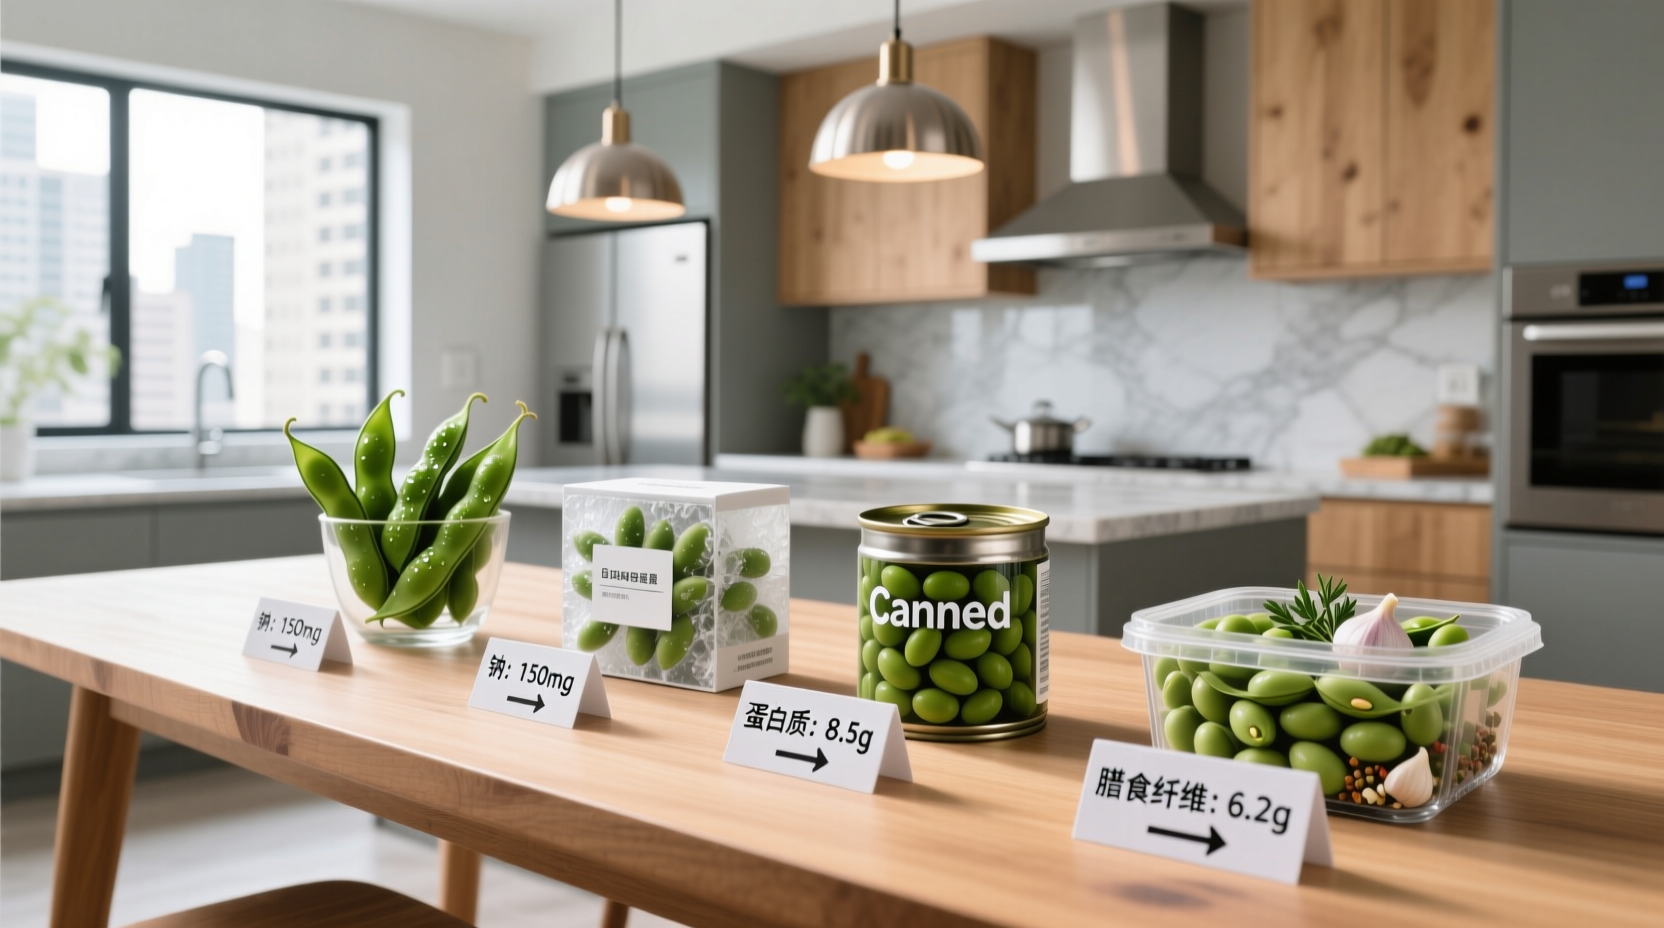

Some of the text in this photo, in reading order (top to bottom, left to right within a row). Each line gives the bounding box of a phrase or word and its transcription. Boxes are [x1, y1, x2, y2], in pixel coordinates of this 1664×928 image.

[869, 585, 1011, 630] Canned
[520, 662, 575, 697] 150mg
[825, 717, 874, 755] 8.5g
[1228, 792, 1292, 835] 6.2g
